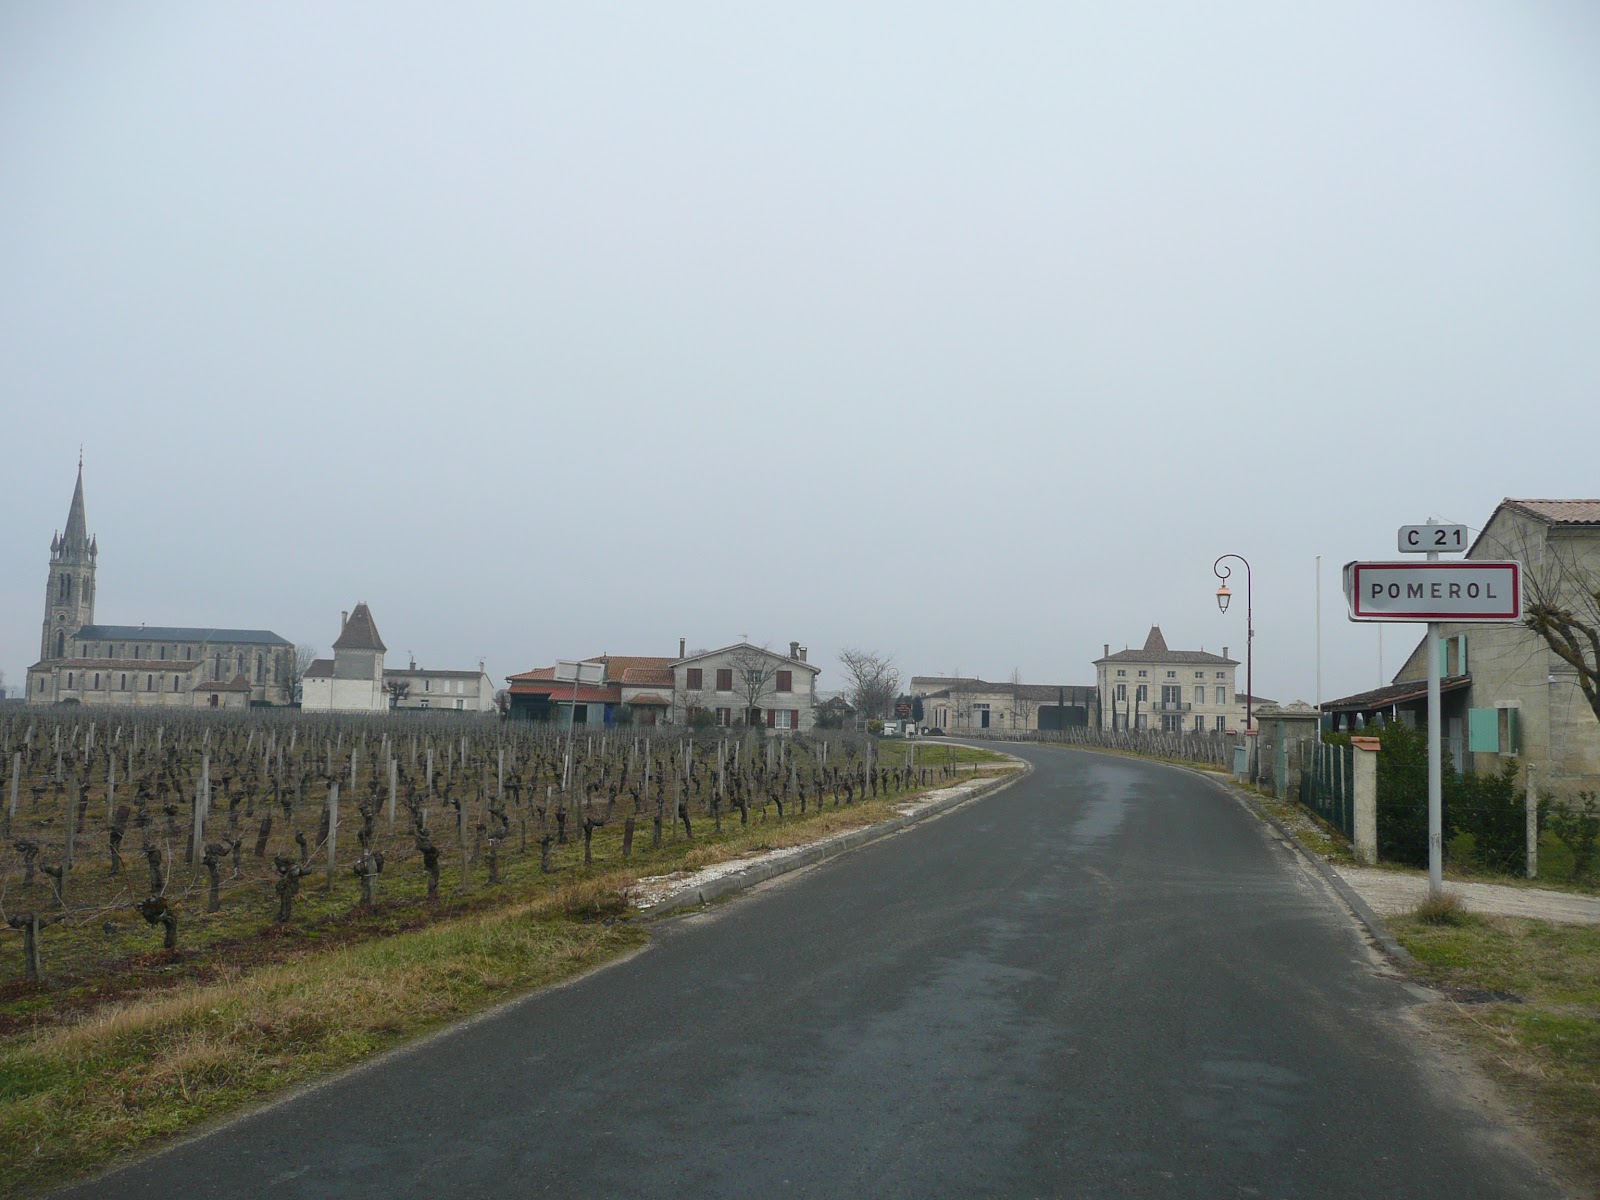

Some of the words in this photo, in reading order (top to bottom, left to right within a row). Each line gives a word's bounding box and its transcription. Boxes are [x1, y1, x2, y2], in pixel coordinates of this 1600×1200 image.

[1407, 530, 1420, 545] C
[1434, 529, 1461, 545] 21
[1371, 582, 1497, 599] POMEROL
